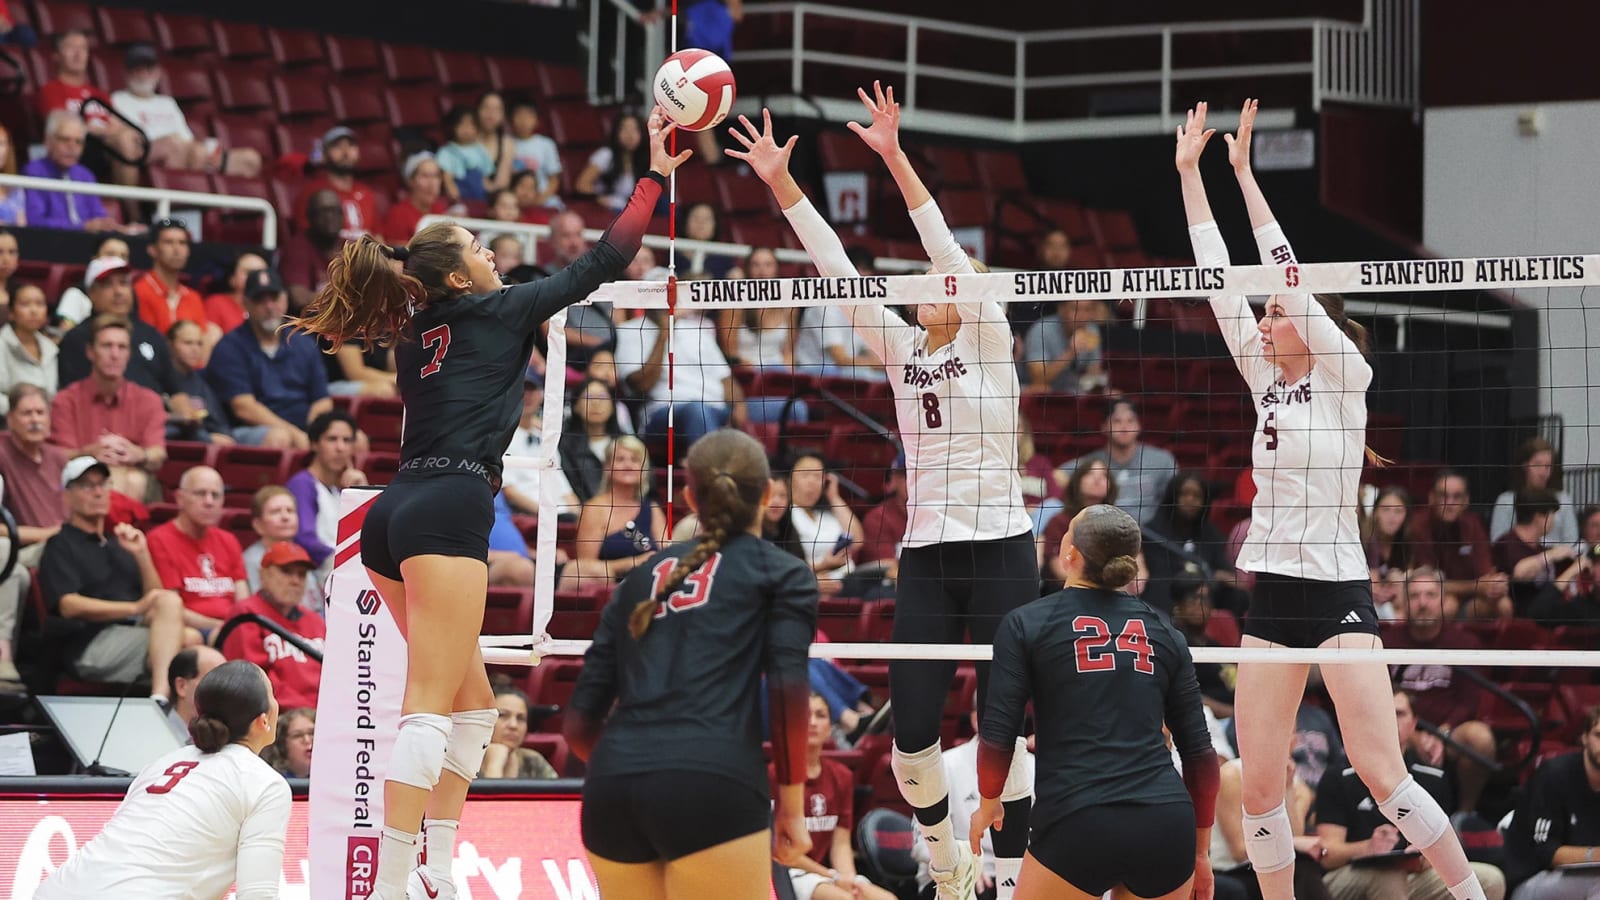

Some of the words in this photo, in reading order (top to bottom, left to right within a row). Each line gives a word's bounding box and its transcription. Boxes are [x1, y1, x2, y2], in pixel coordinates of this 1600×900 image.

[660, 78, 686, 110] Wilson
[1014, 271, 1112, 295] STANFORD
[1122, 268, 1225, 292] ATHLETICS
[1360, 260, 1464, 285] STANFORD
[1475, 256, 1584, 282] ATHLETICS
[690, 280, 781, 302] STANFORD
[791, 277, 887, 300] ATHLETICS
[420, 323, 451, 379] 7
[931, 356, 968, 382] STAE
[922, 392, 942, 428] 8
[1263, 411, 1279, 450] 5
[457, 459, 494, 486] NIK
[649, 551, 722, 619] 13
[1071, 615, 1155, 675] 24
[356, 622, 377, 730] Stanford
[353, 738, 375, 829] Federal
